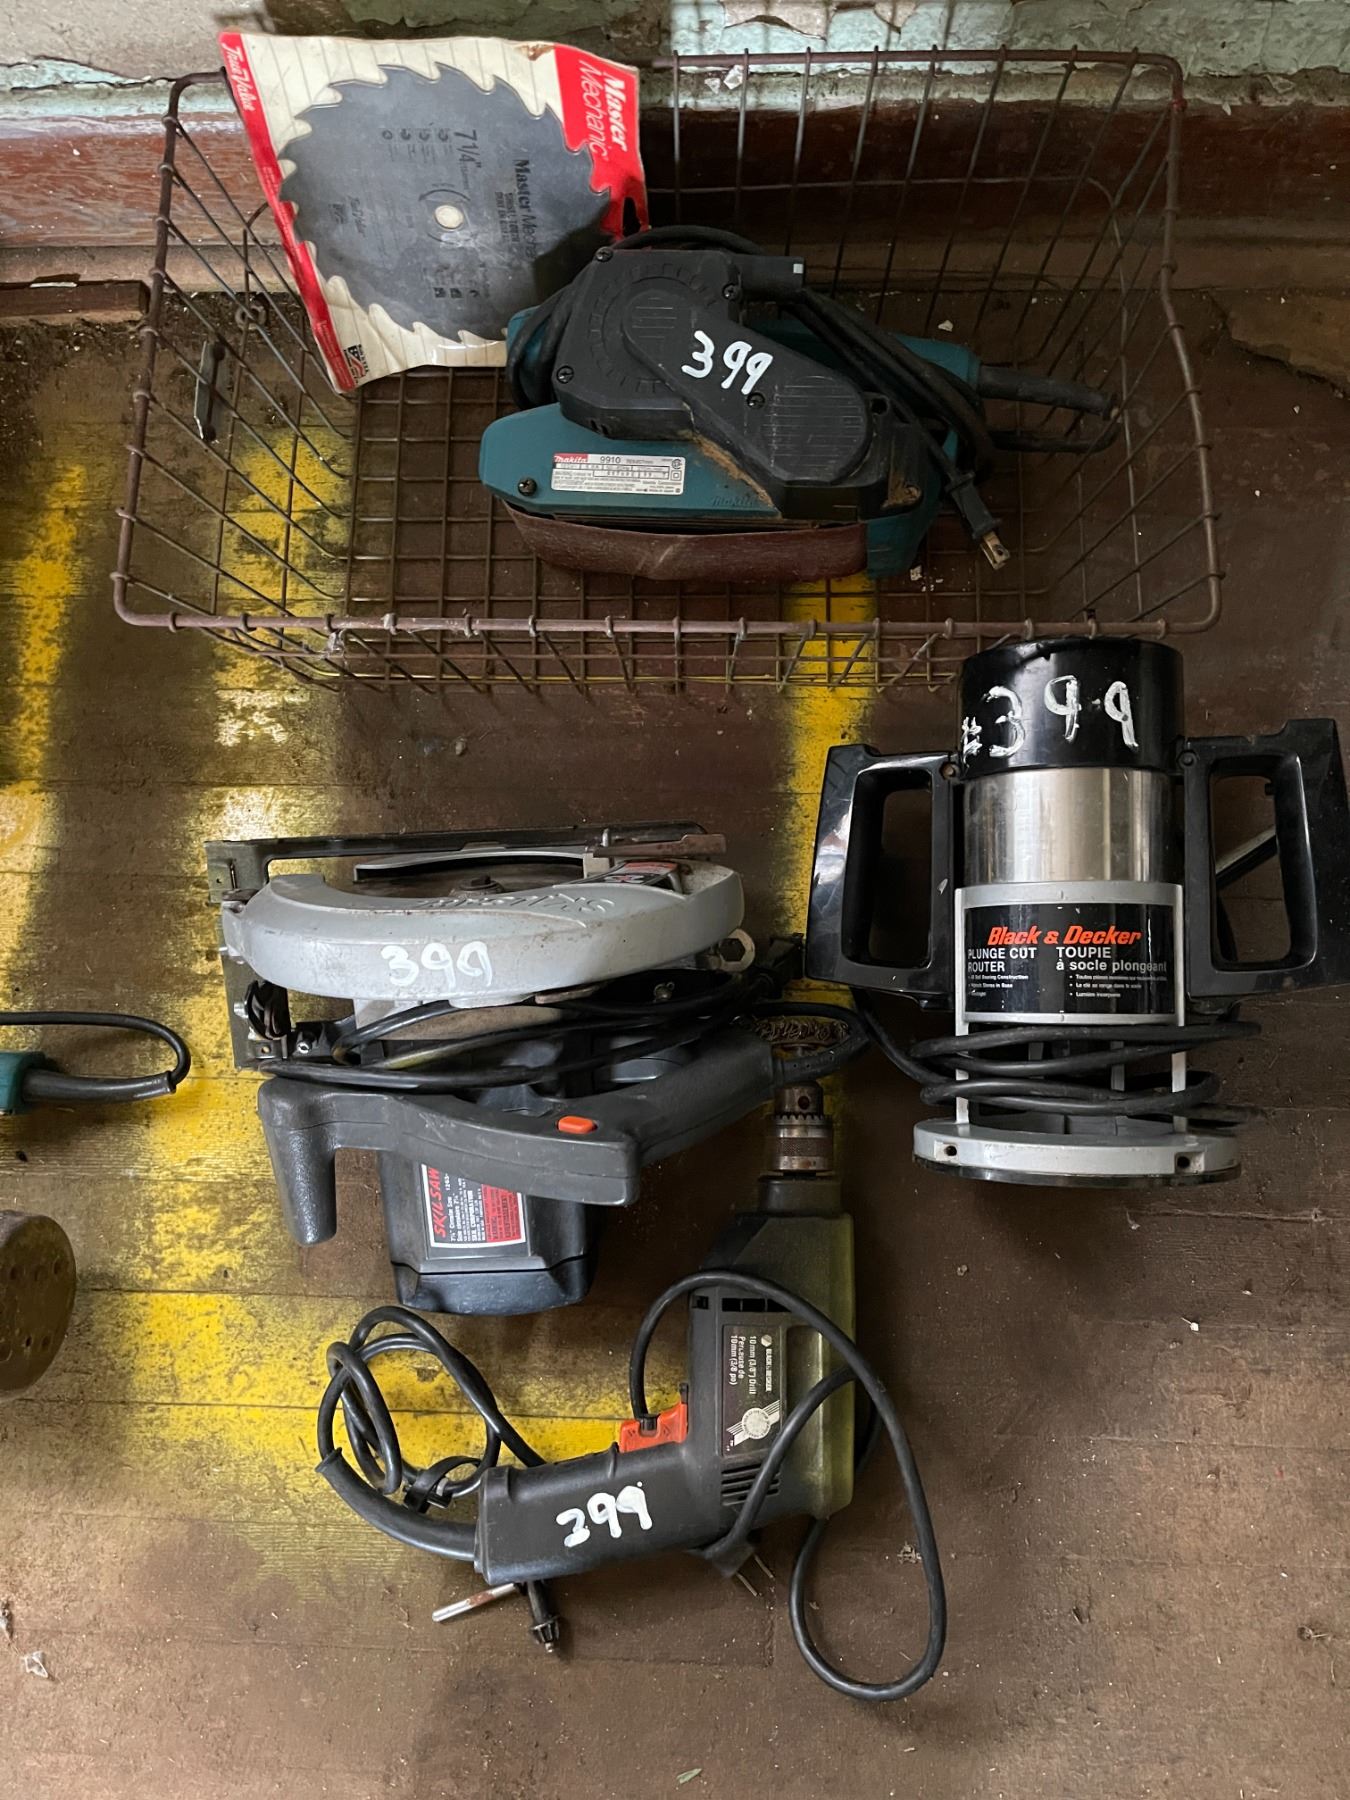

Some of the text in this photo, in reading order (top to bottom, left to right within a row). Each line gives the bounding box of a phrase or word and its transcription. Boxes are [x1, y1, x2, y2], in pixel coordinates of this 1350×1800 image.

[577, 58, 608, 160] Mechanic
[602, 71, 629, 153] Master
[514, 159, 532, 212] Master
[682, 330, 773, 396] 399
[553, 455, 588, 464] makita
[600, 455, 621, 464] 9910
[988, 925, 1142, 946] Black & Decker
[968, 947, 1037, 959] PLUNGE CUT
[1056, 947, 1112, 959] TOUPIE
[380, 941, 493, 988] 399
[968, 961, 1005, 973] ROUTER
[1056, 959, 1065, 971] à
[1069, 959, 1107, 971] socle
[428, 1167, 448, 1238] SKILSAW
[728, 1373, 737, 1386] po)
[737, 1370, 746, 1379] de
[748, 1379, 757, 1395] Drill
